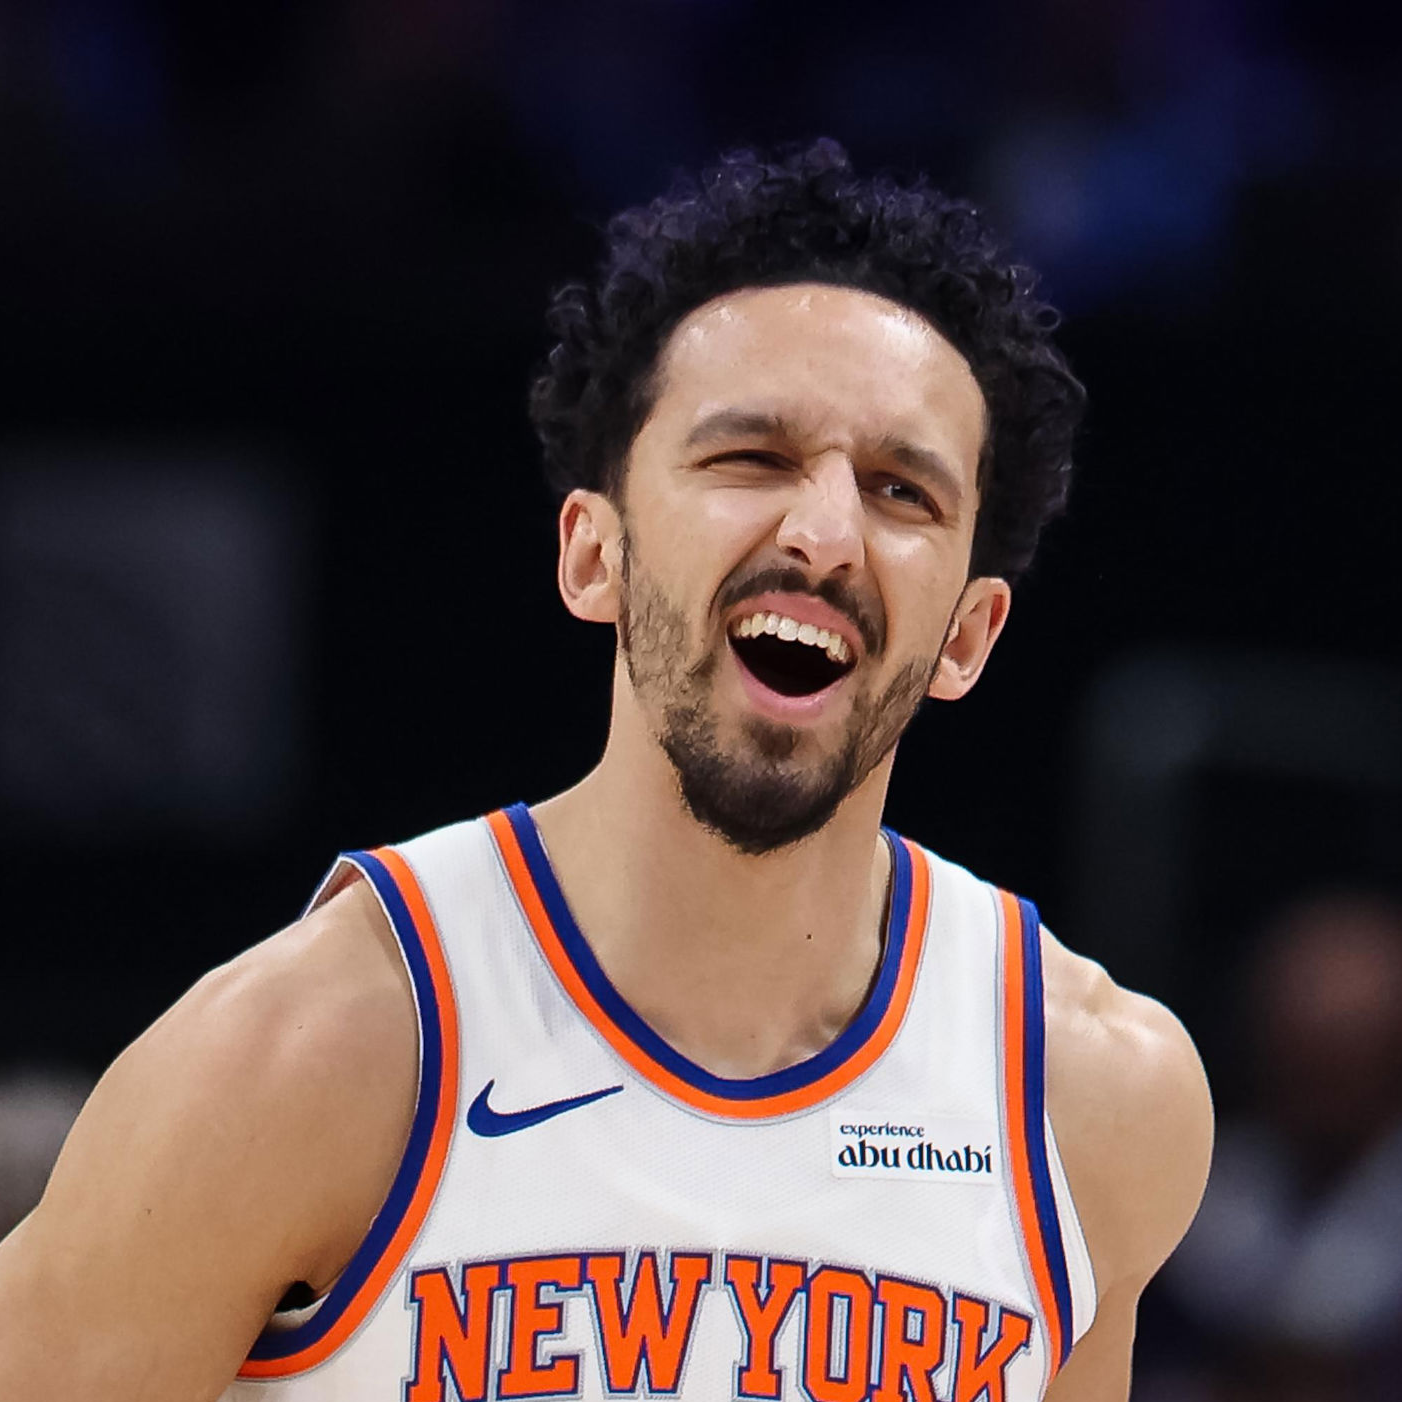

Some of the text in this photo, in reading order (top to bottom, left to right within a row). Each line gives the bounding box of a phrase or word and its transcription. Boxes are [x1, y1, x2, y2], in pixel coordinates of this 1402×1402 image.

[840, 1122, 925, 1138] experience
[838, 1139, 992, 1173] abu dhabi
